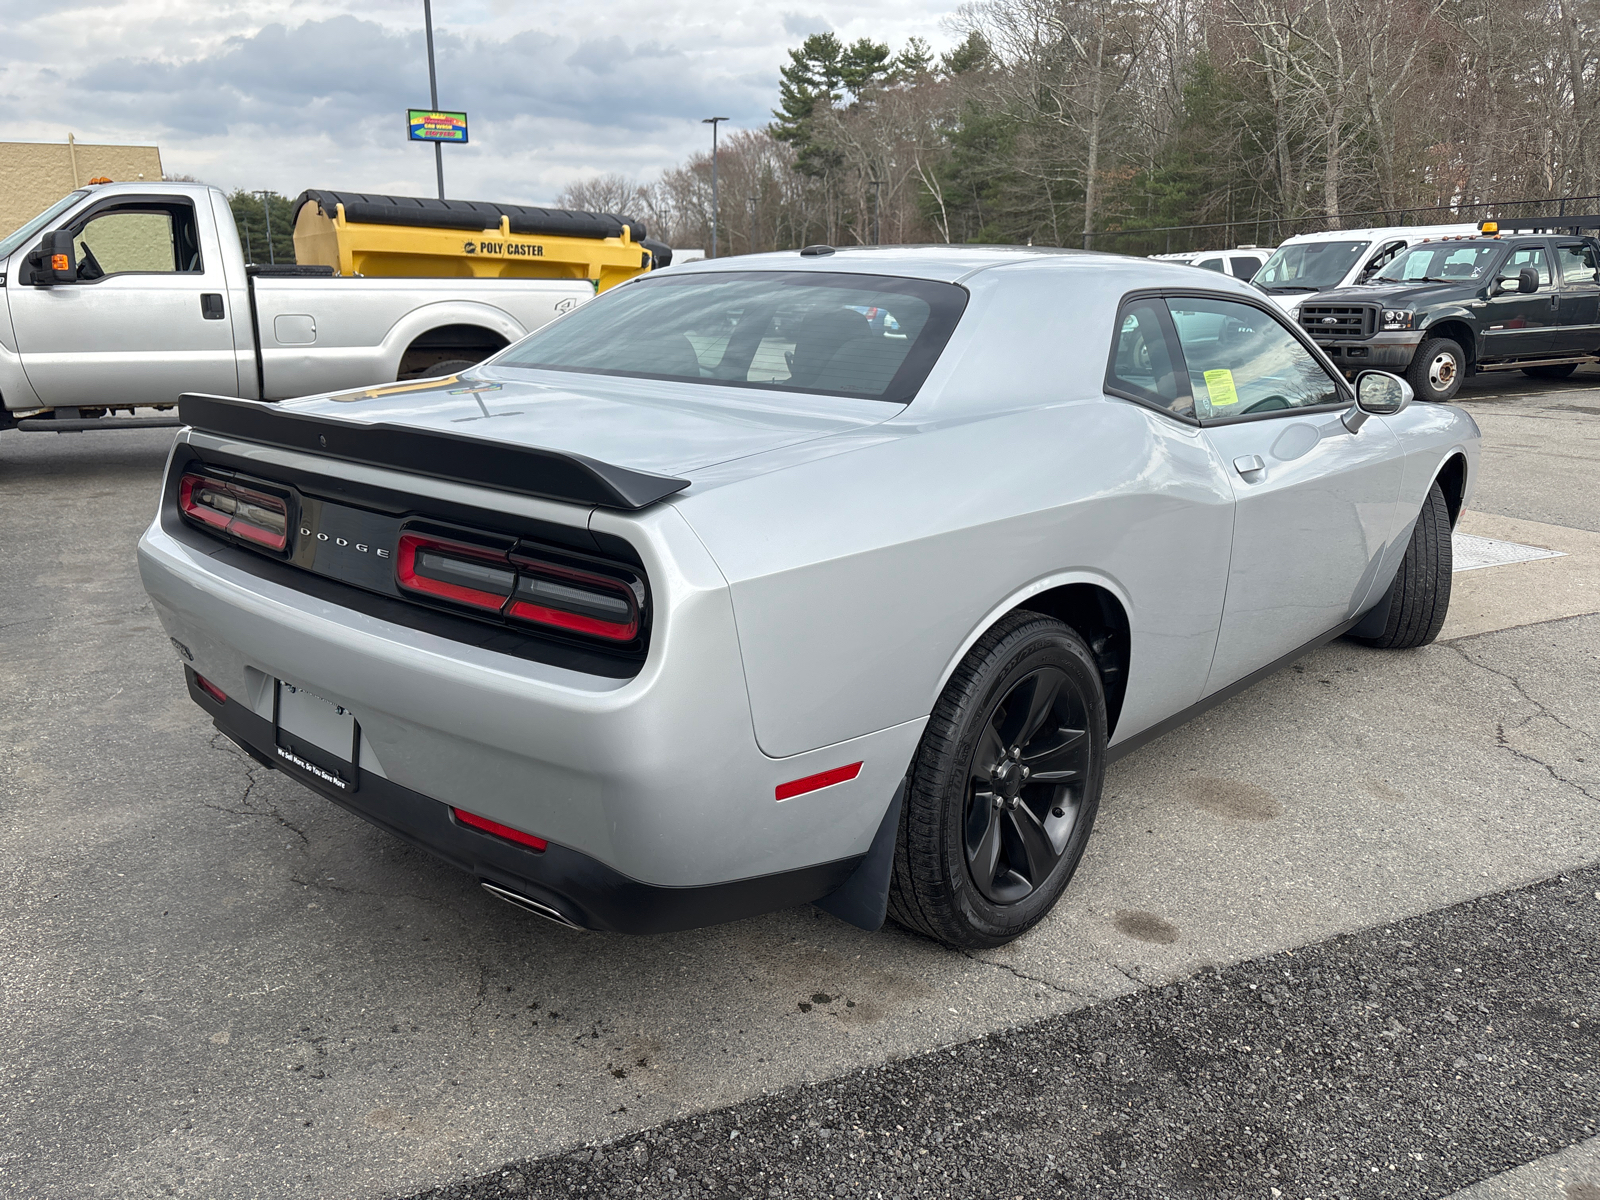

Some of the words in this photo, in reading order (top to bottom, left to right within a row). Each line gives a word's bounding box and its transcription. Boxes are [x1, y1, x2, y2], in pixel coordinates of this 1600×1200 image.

[480, 241, 503, 254] POLY
[507, 243, 544, 257] CASTER
[300, 527, 390, 559] DODGE
[277, 747, 285, 758] We
[285, 752, 293, 762] Sell
[293, 756, 306, 769] More,
[305, 762, 313, 772] So
[312, 766, 322, 777] You
[321, 771, 333, 783] Save
[332, 777, 346, 789] More
